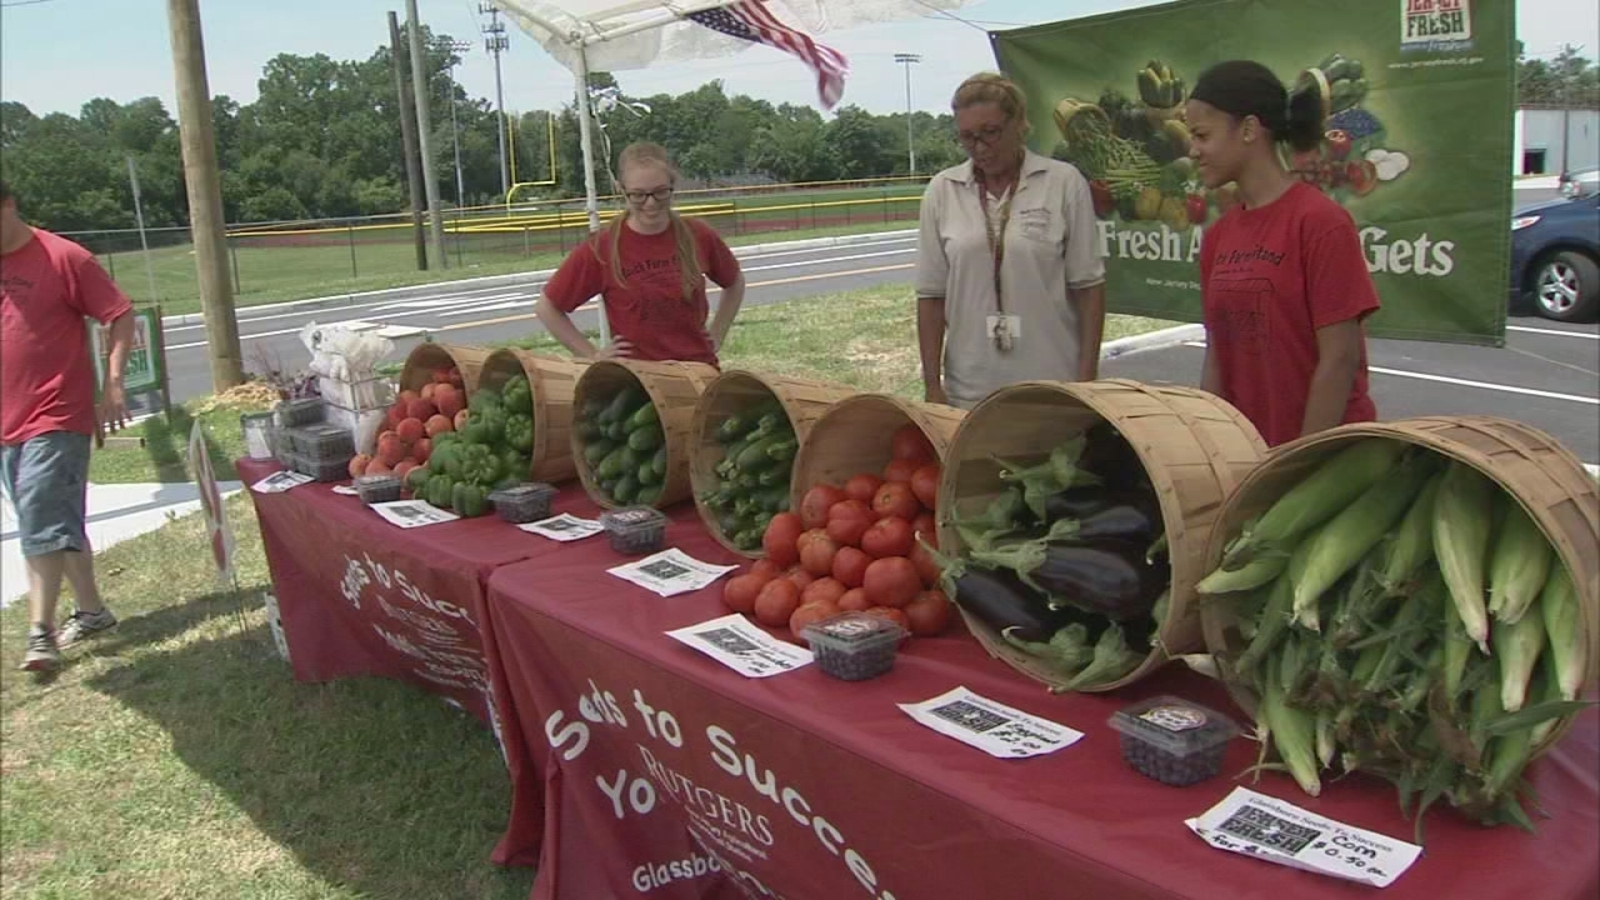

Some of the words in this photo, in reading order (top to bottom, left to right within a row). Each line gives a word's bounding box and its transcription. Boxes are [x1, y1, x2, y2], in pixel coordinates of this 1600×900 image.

[1407, 11, 1464, 38] FRESH
[1095, 220, 1182, 262] Fresh
[1189, 223, 1201, 262] A
[1360, 226, 1455, 276] Gets
[363, 551, 392, 590] to
[394, 569, 482, 631] Succ
[596, 769, 656, 824] Yo
[633, 689, 684, 748] to
[706, 724, 897, 900] Succe
[636, 743, 774, 846] RUTGERS
[1234, 804, 1319, 840] JERSEY
[632, 851, 723, 892] Glassbo
